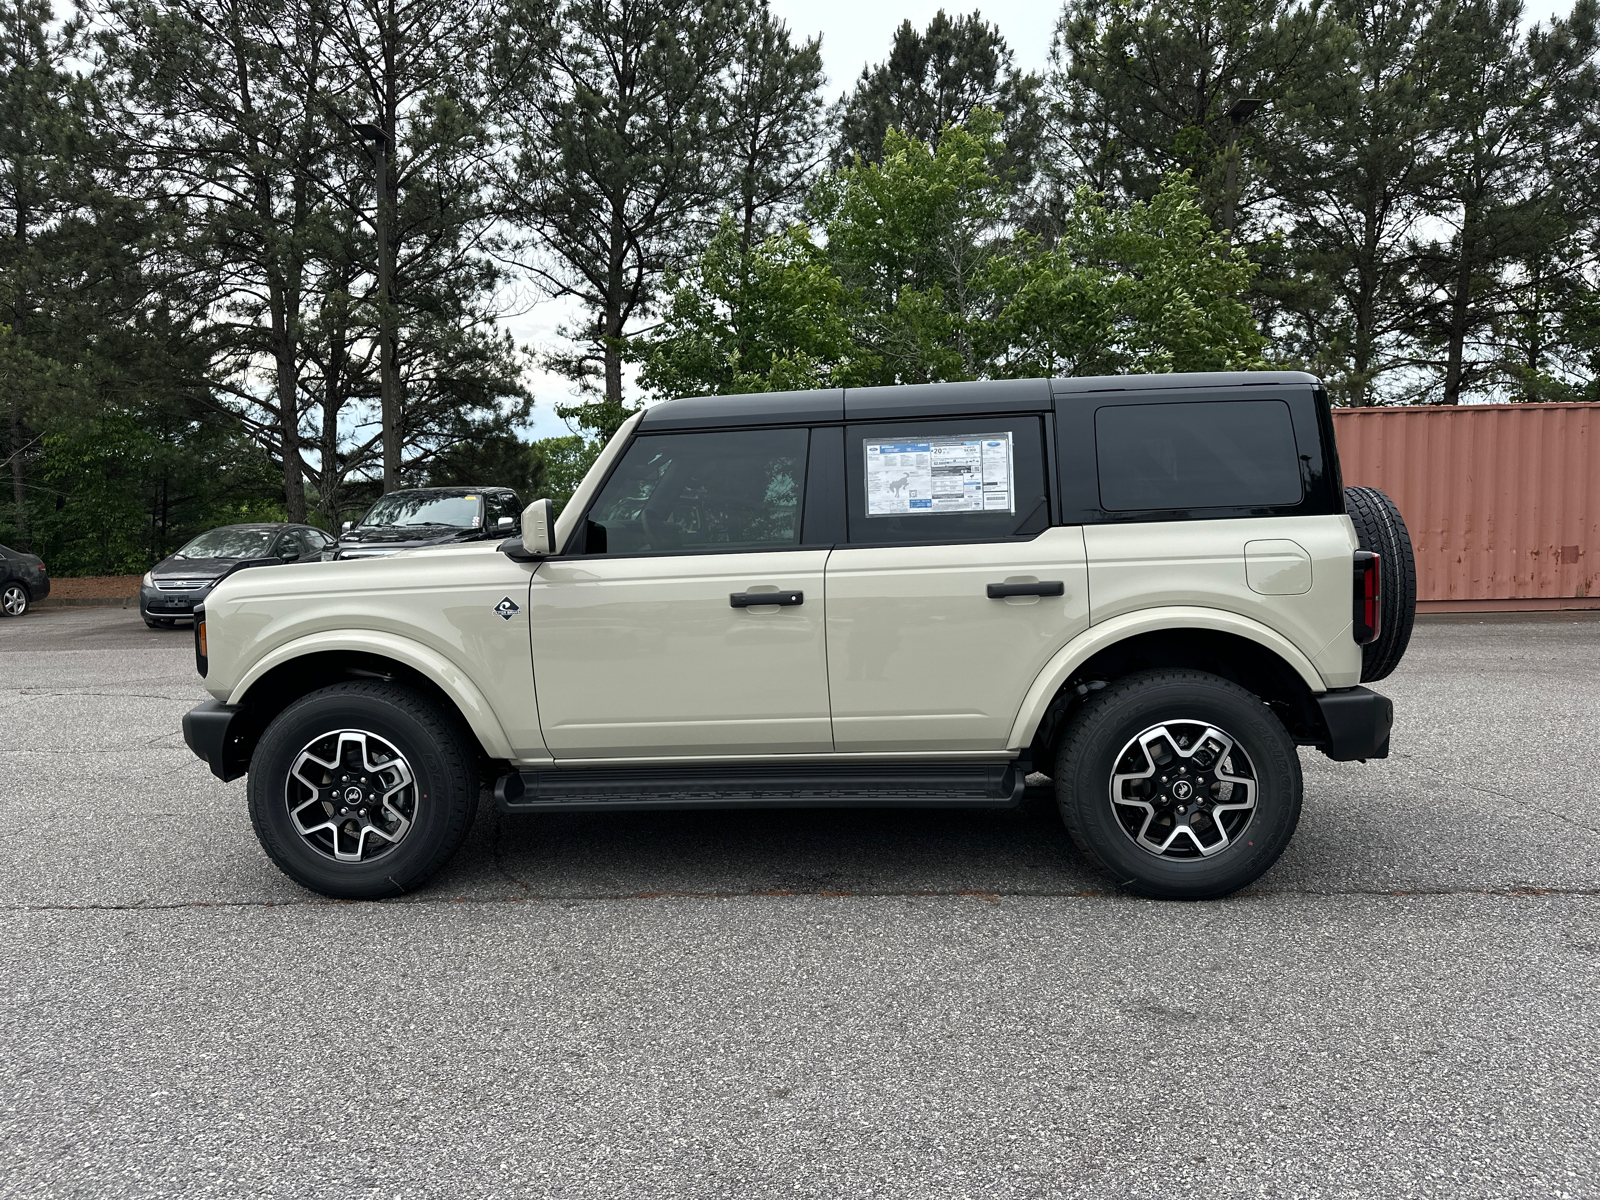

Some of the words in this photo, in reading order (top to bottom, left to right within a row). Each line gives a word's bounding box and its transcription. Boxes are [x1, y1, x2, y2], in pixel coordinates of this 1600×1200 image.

[255, 717, 300, 859] BRIDGESTONE
[1079, 727, 1111, 847] DUELER
[1245, 720, 1292, 874] BRIDGESTONE
